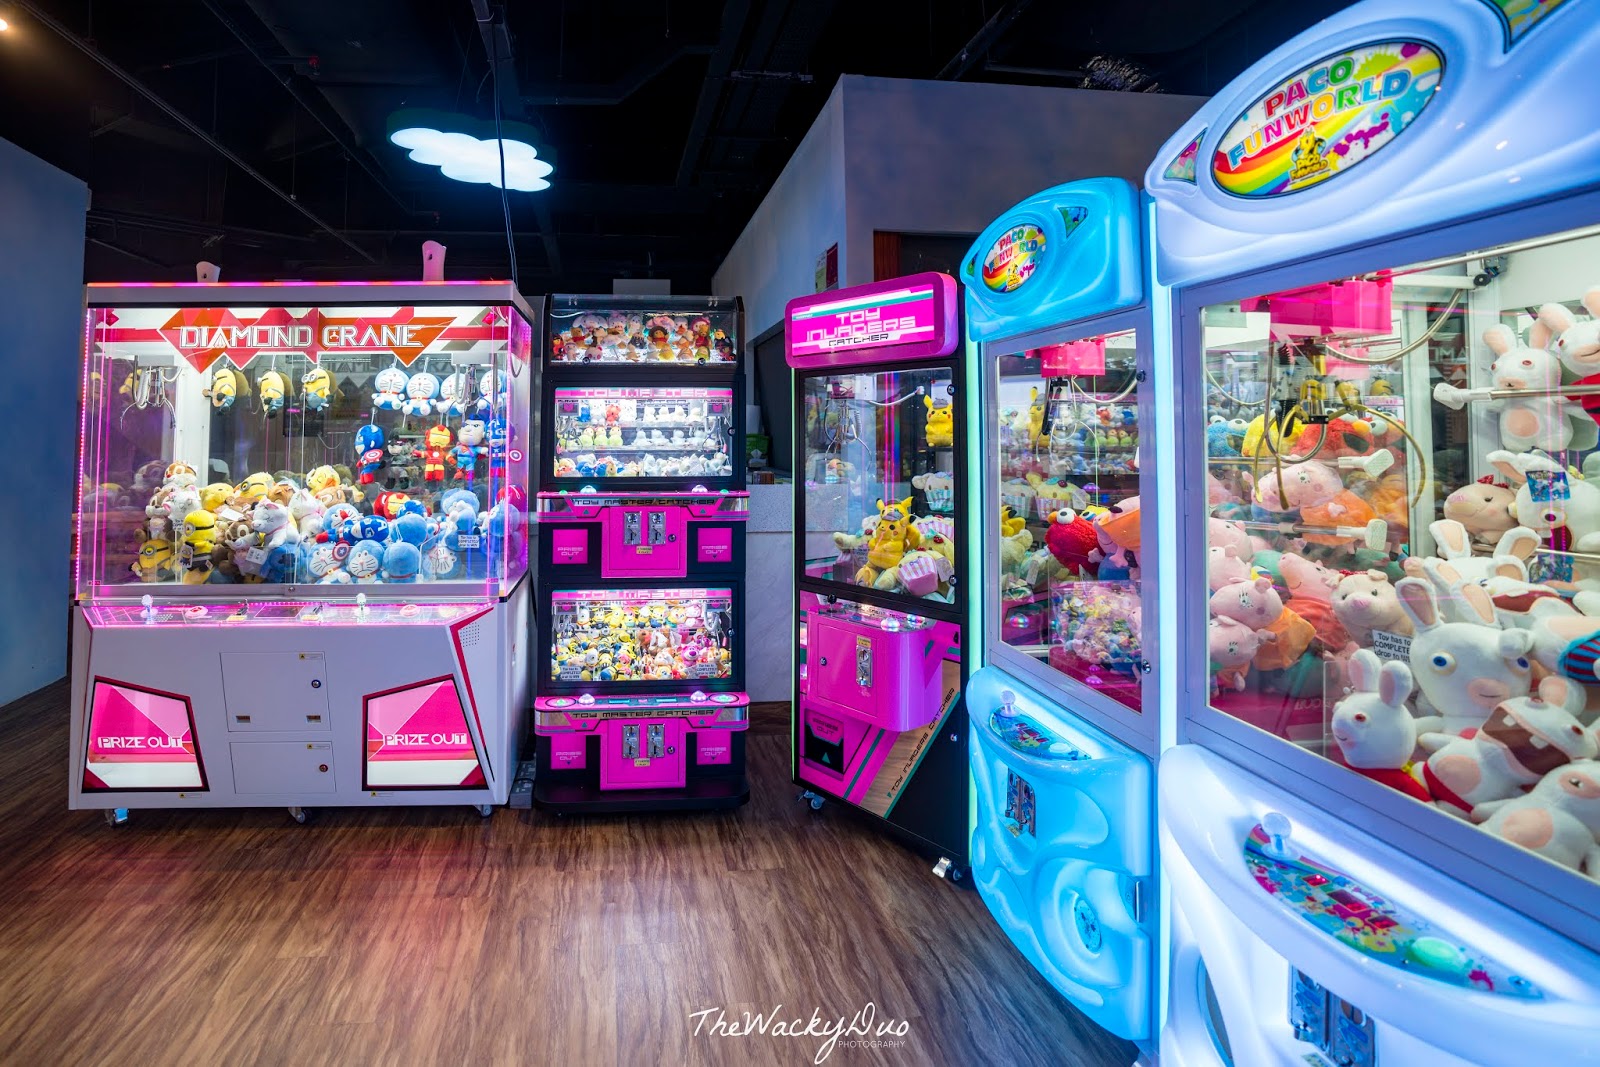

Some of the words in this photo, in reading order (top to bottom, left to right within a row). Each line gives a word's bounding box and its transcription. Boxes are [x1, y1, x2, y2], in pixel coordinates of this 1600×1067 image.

[1264, 57, 1355, 119] PACO
[1227, 69, 1412, 170] FUNWORLD
[998, 228, 1024, 251] PACO
[988, 239, 1038, 272] FUNWORLD
[836, 307, 880, 325] TOY
[180, 324, 313, 349] DIAMOND
[322, 324, 425, 349] CRANE
[806, 316, 916, 342] INVADERS
[828, 333, 889, 347] CATCHER
[1374, 640, 1410, 655] COMPLETE
[1377, 632, 1389, 641] Toy
[1390, 635, 1402, 645] has
[97, 736, 147, 748] PRIZE
[147, 736, 183, 749] OUT
[384, 733, 430, 746] PRIZE
[431, 732, 467, 745] OUT
[891, 774, 903, 791] TOY
[903, 732, 928, 774] INVADERS
[928, 687, 955, 730] CATCHER
